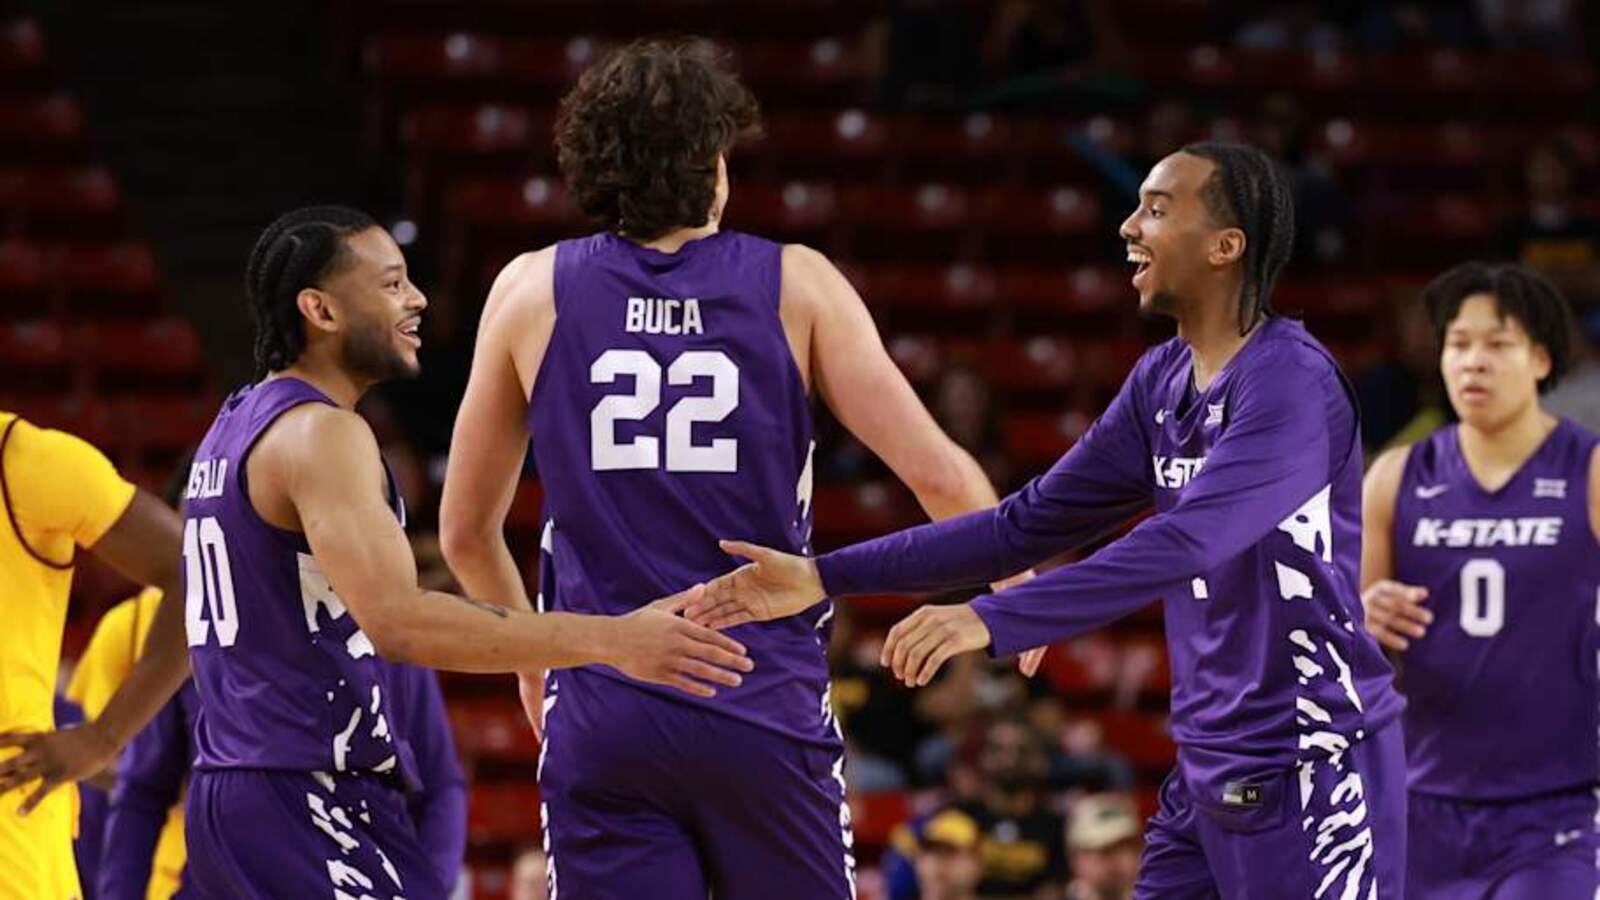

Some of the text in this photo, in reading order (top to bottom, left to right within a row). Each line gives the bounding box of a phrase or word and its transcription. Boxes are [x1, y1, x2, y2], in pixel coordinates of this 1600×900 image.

[626, 298, 703, 335] BUCA
[591, 350, 739, 472] 22
[1414, 517, 1563, 546] K-STATE
[183, 517, 239, 648] 10
[1460, 559, 1505, 637] 0
